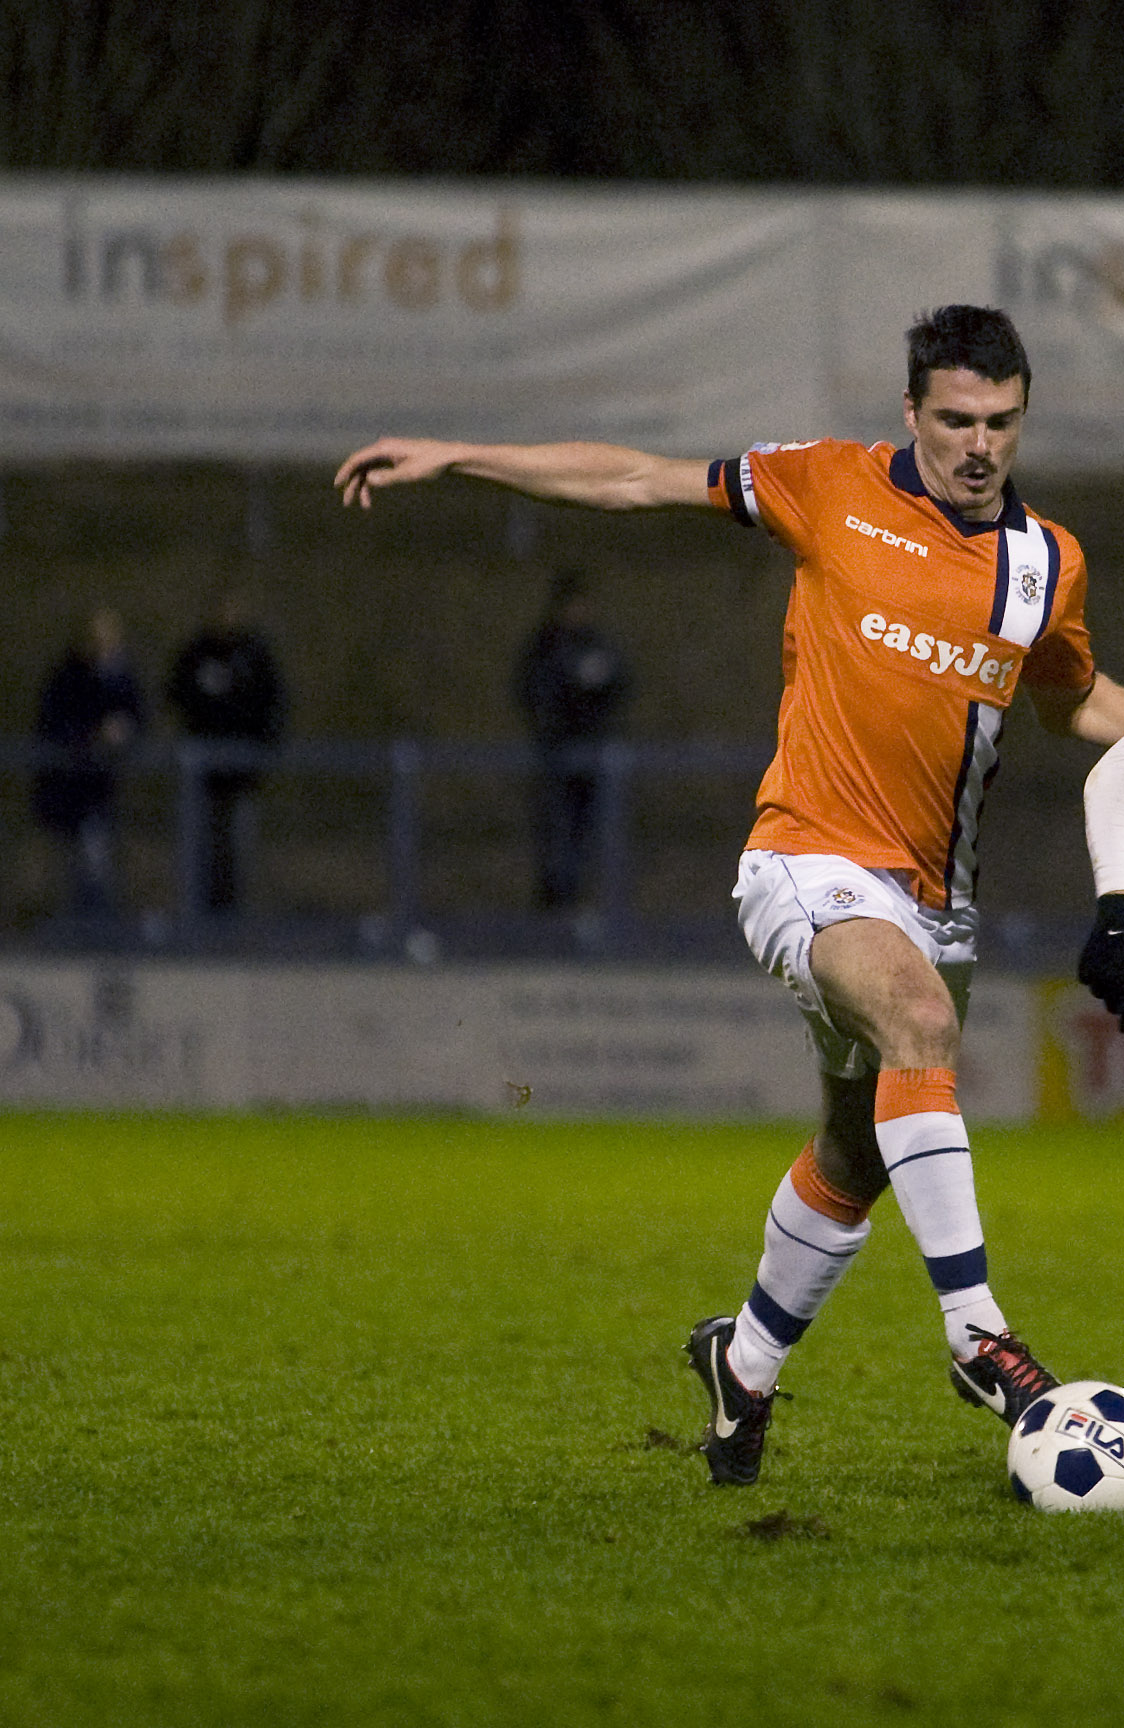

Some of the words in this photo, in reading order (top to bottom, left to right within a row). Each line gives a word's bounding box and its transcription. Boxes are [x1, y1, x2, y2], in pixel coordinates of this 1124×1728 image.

[60, 198, 520, 330] inspired
[845, 514, 929, 558] carbrini
[860, 612, 1014, 689] easyJet
[1064, 1413, 1124, 1460] FILA
